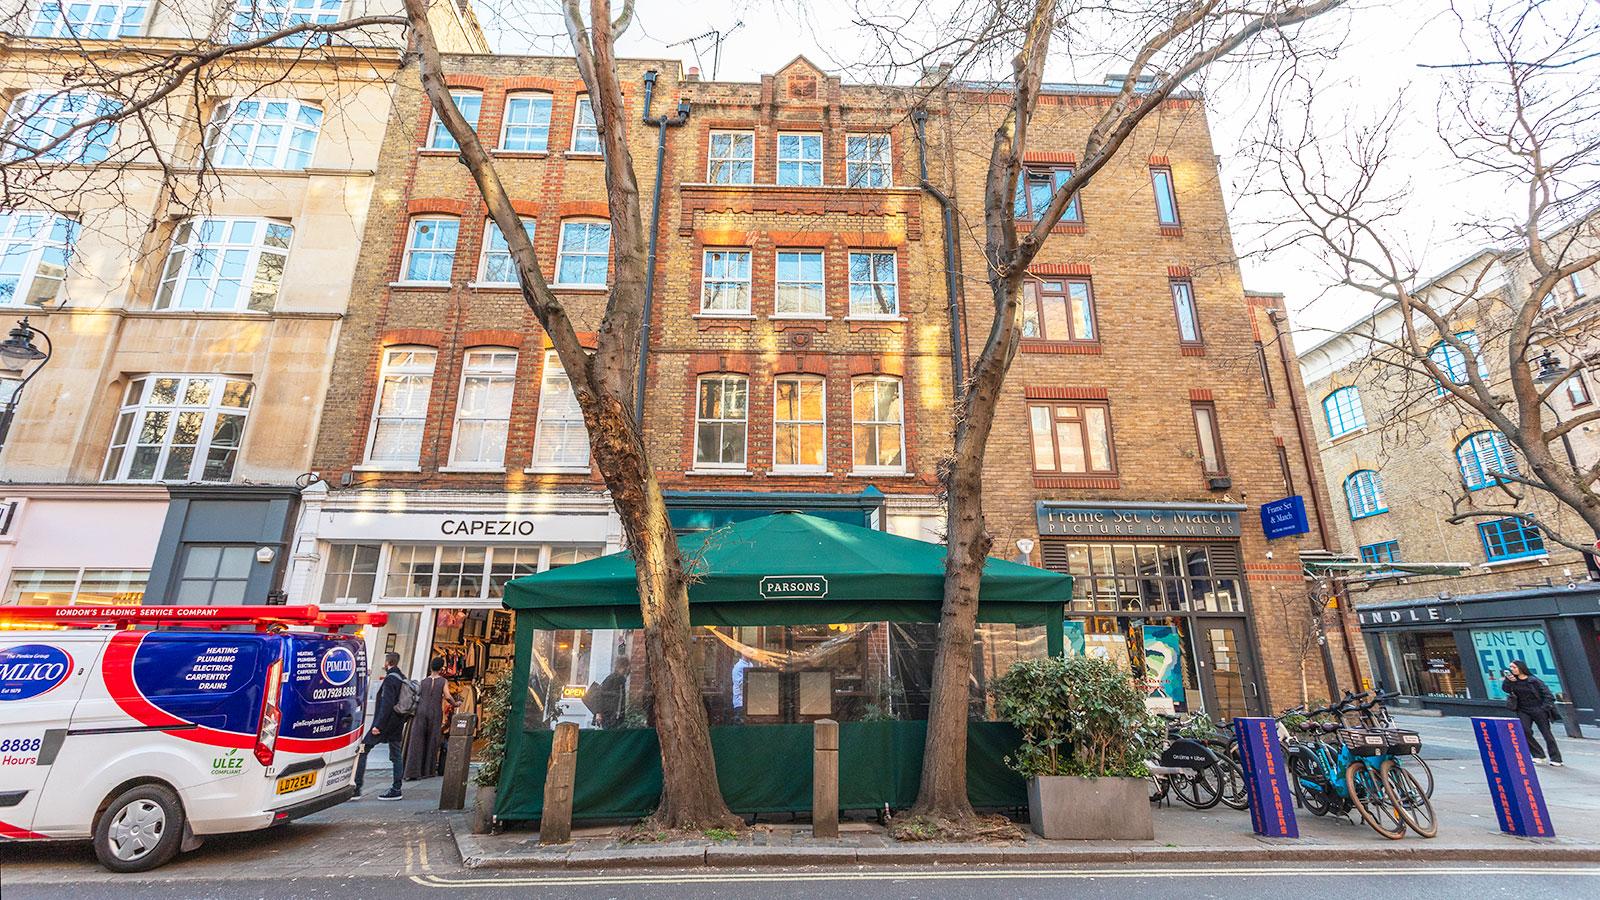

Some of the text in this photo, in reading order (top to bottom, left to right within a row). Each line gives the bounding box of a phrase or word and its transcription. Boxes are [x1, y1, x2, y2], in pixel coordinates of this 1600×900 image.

[1048, 507, 1232, 524] Frame Set & Match
[441, 519, 535, 536] CAPEZIO
[1048, 523, 1235, 535] PICTURE FRAMERS
[767, 582, 820, 592] PARSONS
[1473, 630, 1548, 647] FINE TO
[326, 660, 352, 672] PIMLICO
[198, 682, 228, 690] DRAINS
[313, 689, 327, 700] 020
[563, 688, 585, 698] OPEN
[0, 738, 40, 752] 8888
[2, 755, 36, 765] Hours
[213, 758, 244, 769] ULEZ
[1260, 722, 1287, 834] PICTURE FRAMERS
[1480, 722, 1515, 831] PICTURE FRAMERS
[1507, 723, 1545, 834] PICTURE FRAMERS
